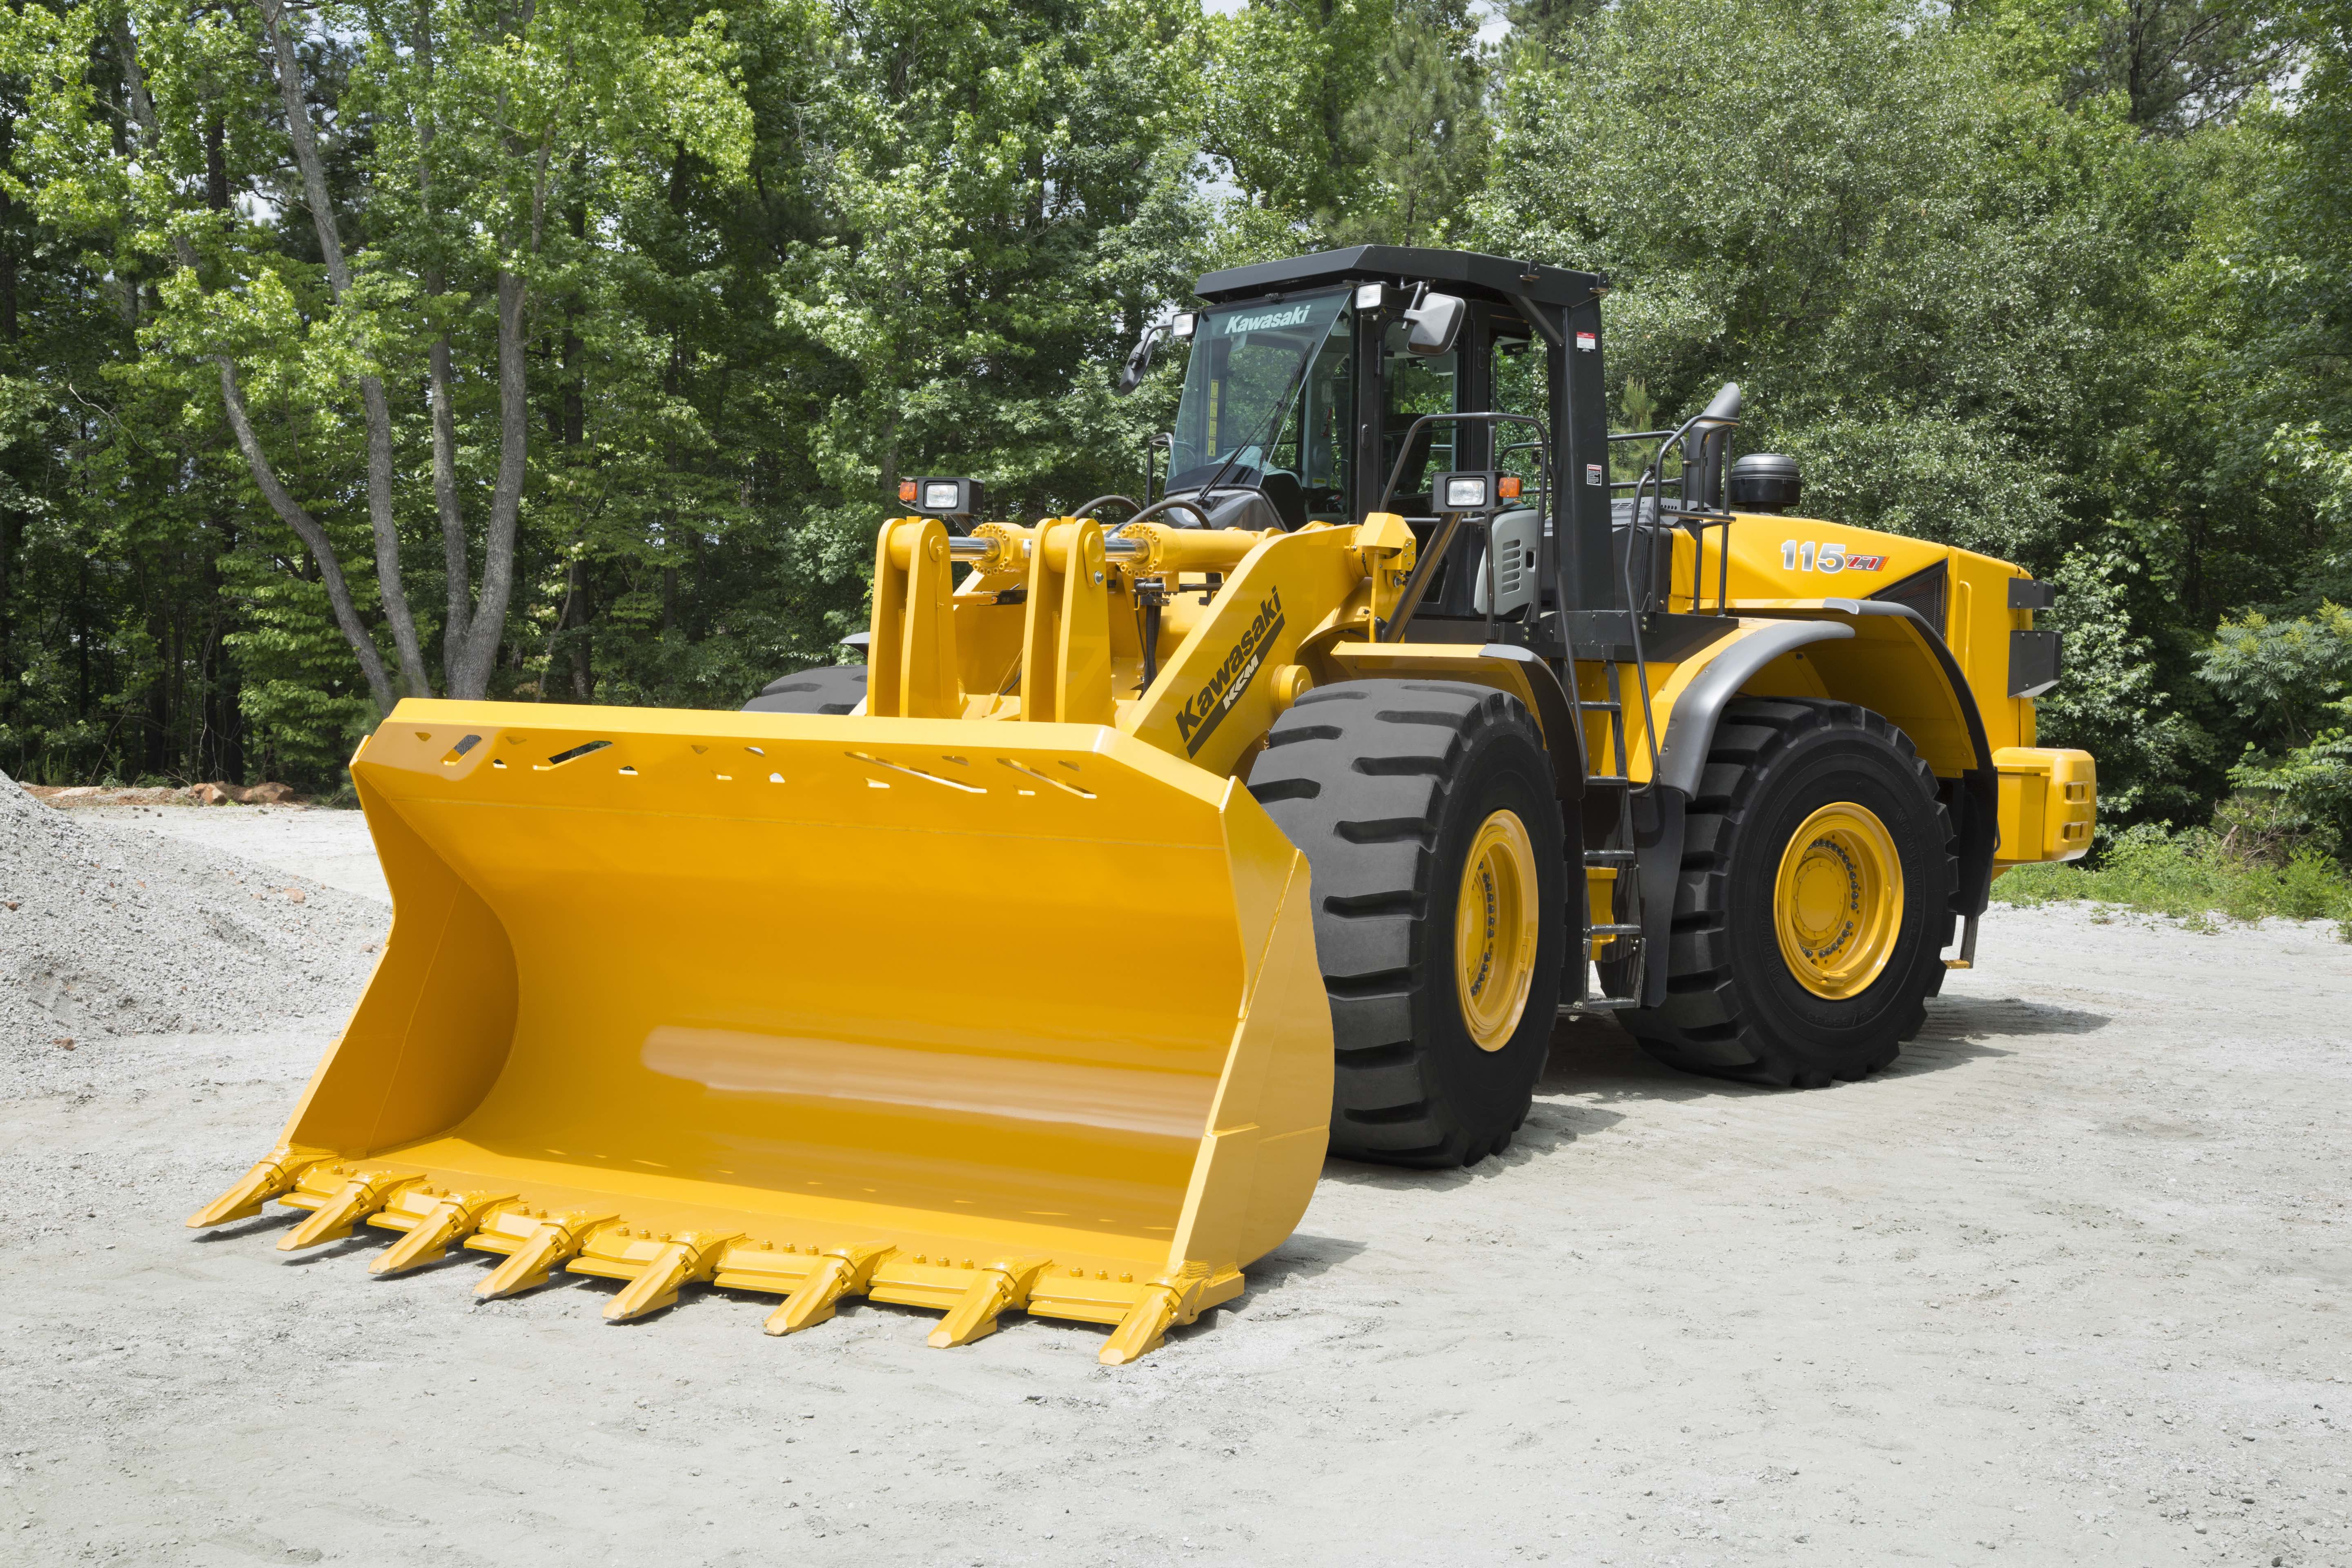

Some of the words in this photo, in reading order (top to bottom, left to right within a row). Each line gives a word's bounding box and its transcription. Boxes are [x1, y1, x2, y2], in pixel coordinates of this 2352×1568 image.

[1224, 305, 1311, 334] Kawasaki
[1175, 585, 1282, 743] Kawasaki
[1223, 653, 1259, 710] KCM
